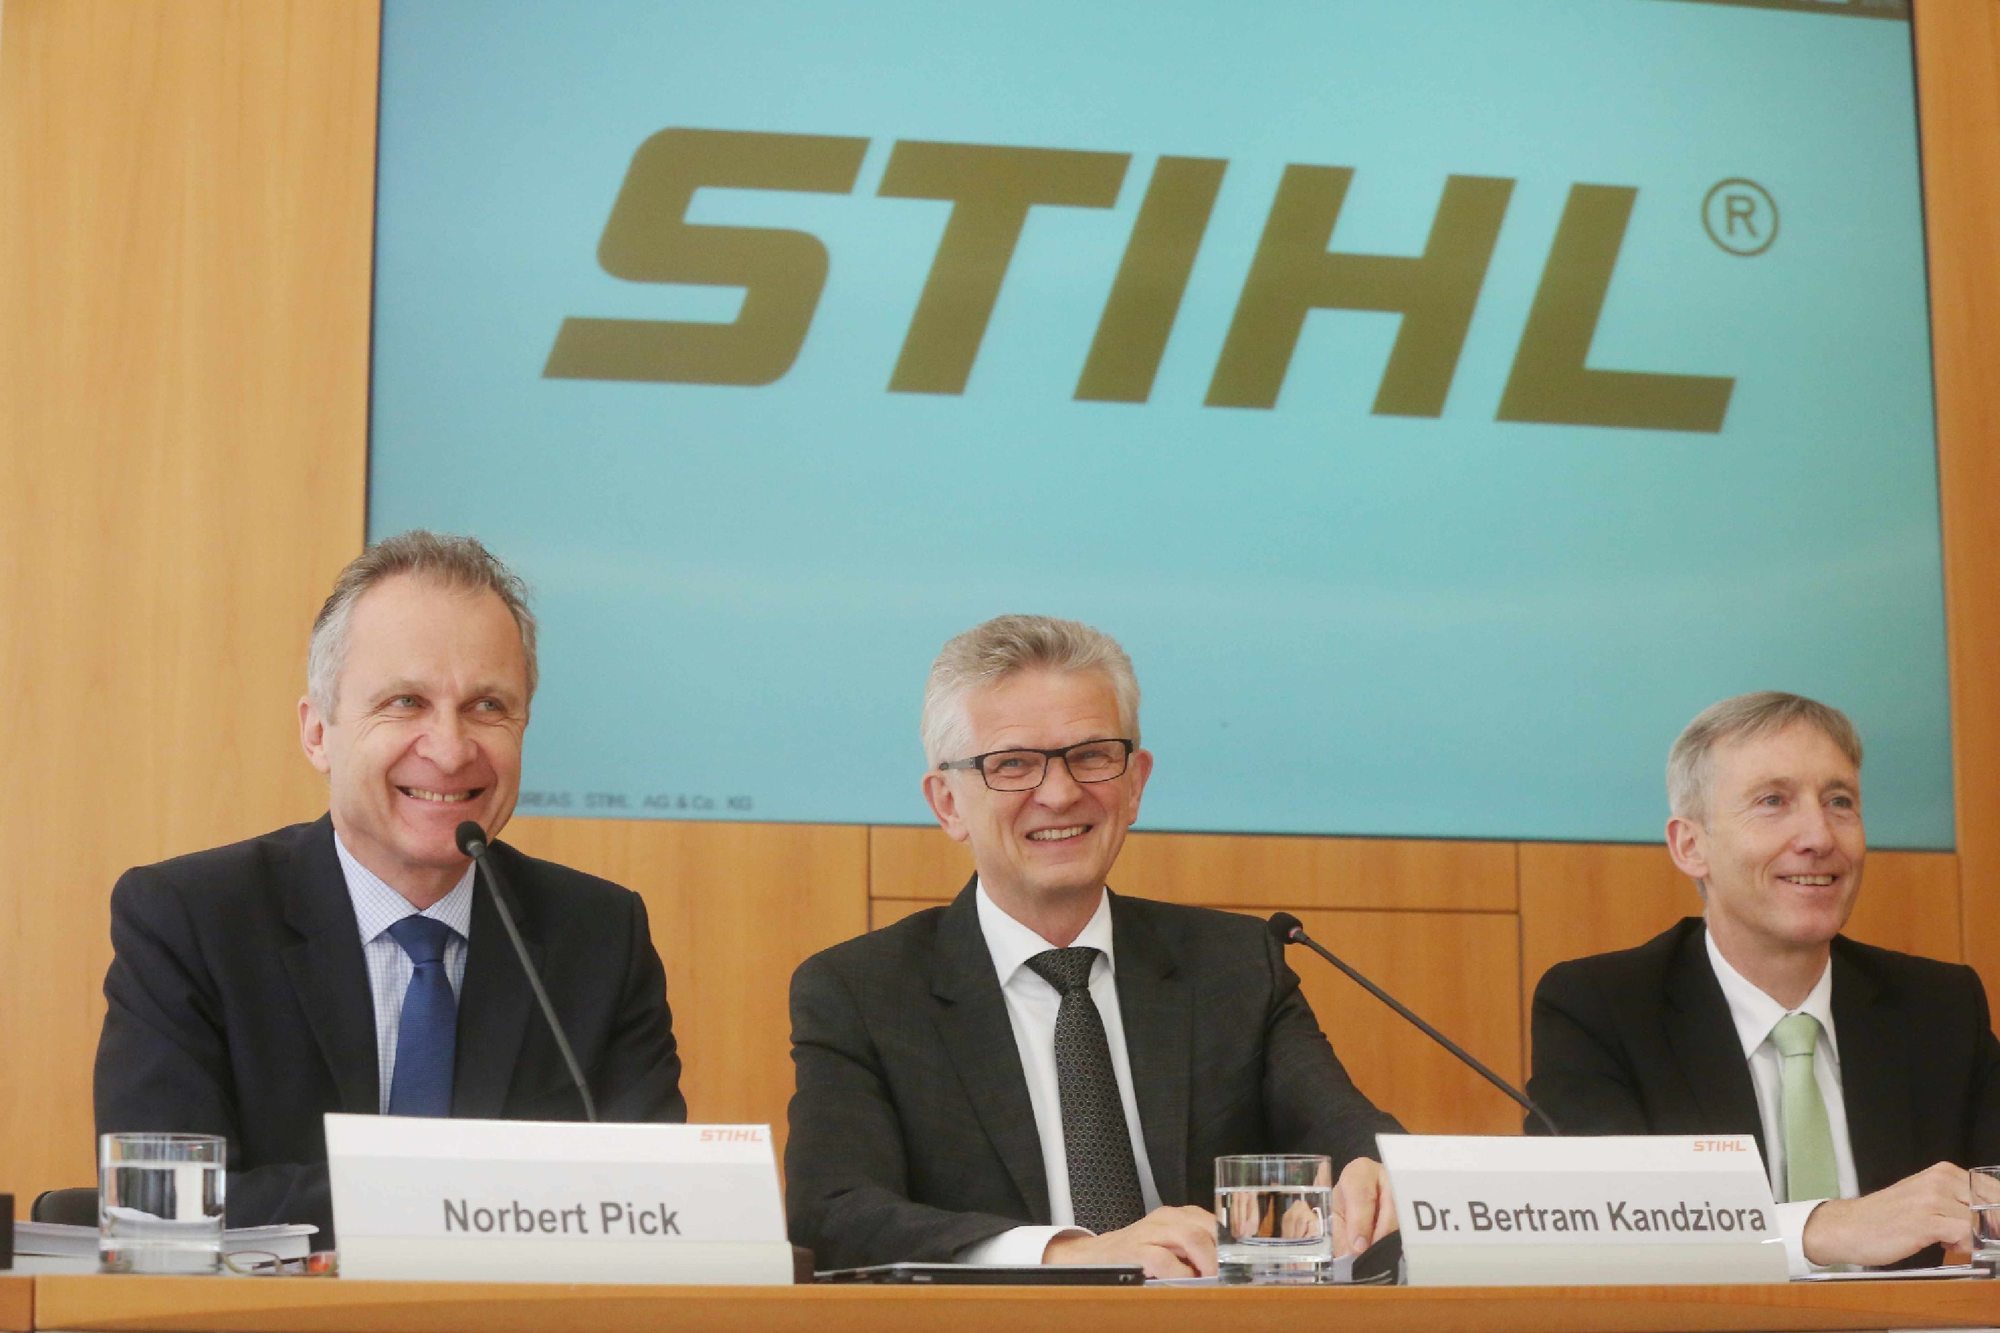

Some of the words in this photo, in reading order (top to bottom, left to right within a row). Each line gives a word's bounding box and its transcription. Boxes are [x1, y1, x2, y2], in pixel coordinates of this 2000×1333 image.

[543, 126, 1736, 434] STIHL
[700, 1130, 763, 1141] STIHL
[1692, 1140, 1747, 1152] STIHL
[443, 1199, 589, 1233] Norbert
[600, 1202, 681, 1235] Pick
[1413, 1201, 1460, 1231] Dr.
[1468, 1201, 1598, 1232] Bertram
[1606, 1201, 1766, 1232] Kandziora
